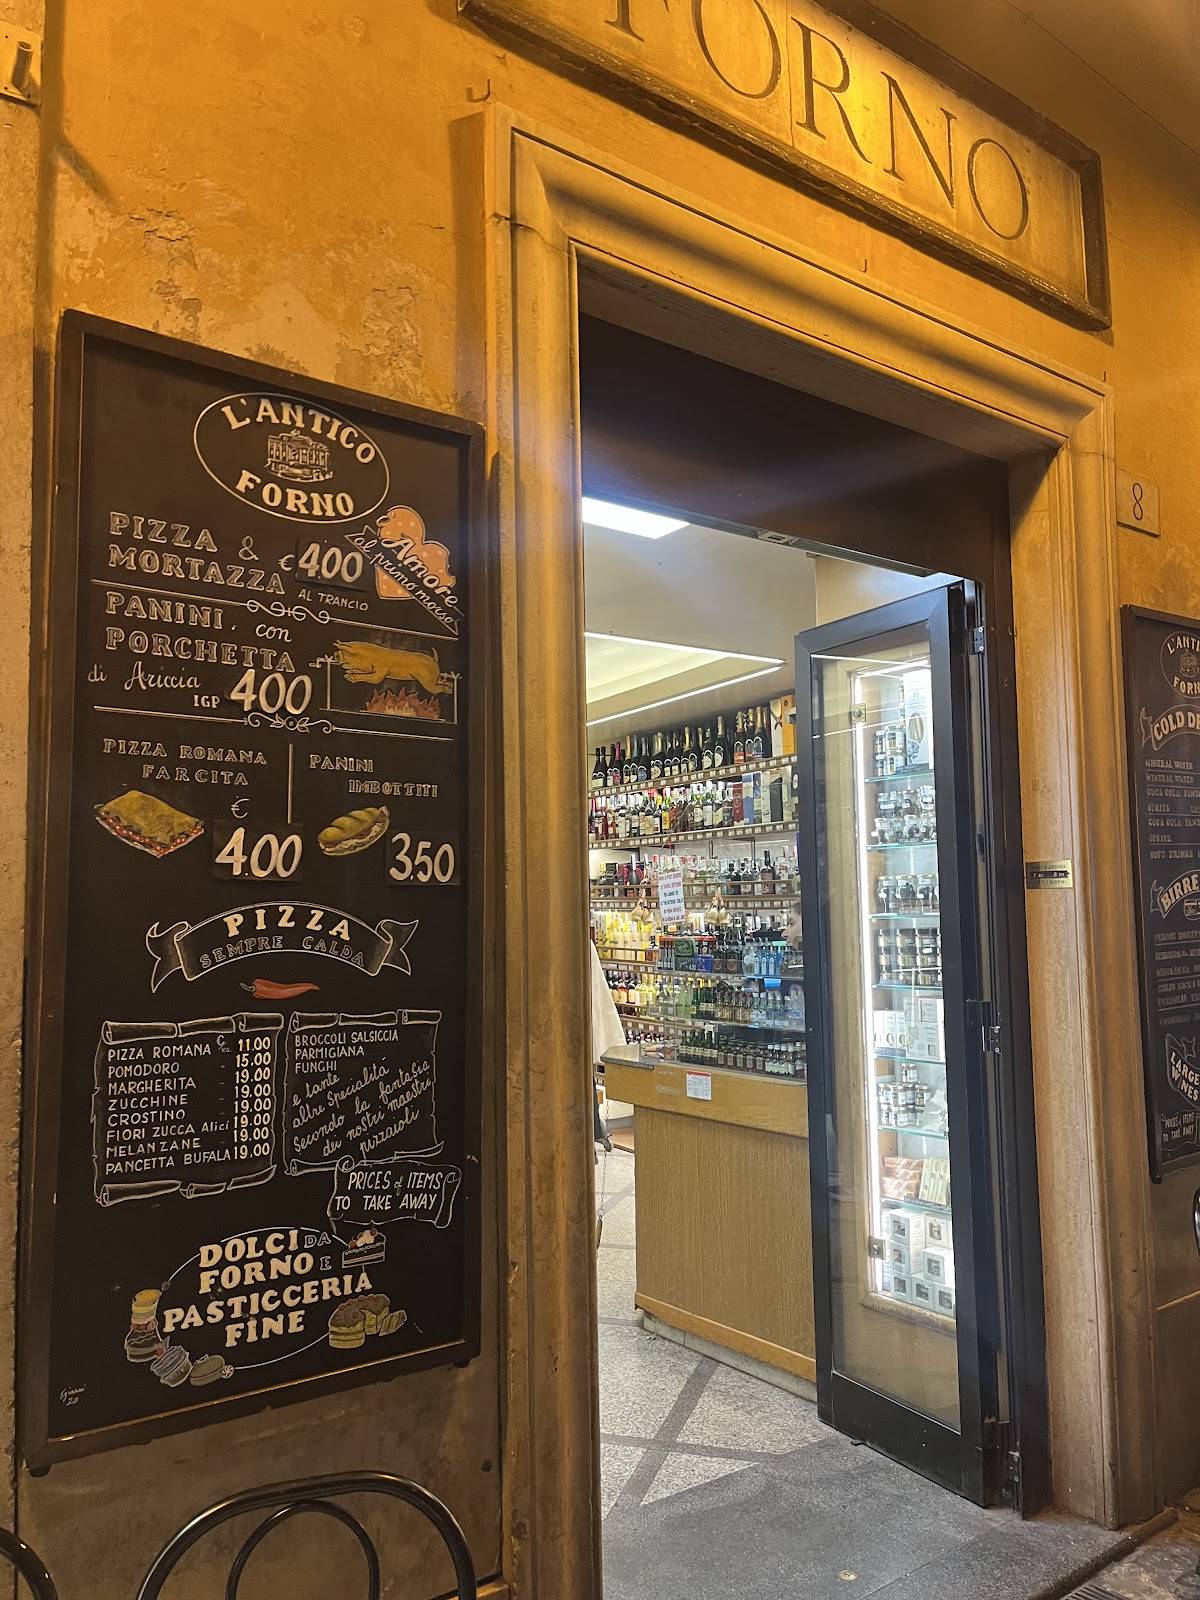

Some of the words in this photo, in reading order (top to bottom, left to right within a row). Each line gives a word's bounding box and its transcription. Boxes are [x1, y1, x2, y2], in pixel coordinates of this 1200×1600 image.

[221, 398, 376, 463] L'ANTICO
[235, 469, 354, 517] FORNO
[1132, 482, 1143, 521] 8
[109, 511, 218, 552] PIZZA
[238, 535, 259, 561] &
[108, 544, 286, 594] MORTAZZA
[354, 537, 378, 553] al
[369, 552, 419, 591] primo
[414, 589, 454, 624] morso
[381, 533, 458, 608] Amore
[297, 588, 313, 602] AL
[318, 591, 368, 612] TRANCIO
[255, 624, 292, 643] con
[105, 626, 295, 673] PORCHETTA
[88, 663, 107, 683] di
[124, 660, 201, 690] Ariccia
[193, 694, 221, 709] IGP
[1153, 710, 1185, 741] COLD
[103, 738, 168, 757] PIZZA
[179, 745, 268, 765] ROMANA
[309, 754, 374, 773] PANINI
[142, 764, 249, 786] FARCITA
[348, 779, 438, 798] IMBOTTITI
[230, 798, 250, 819] €
[223, 905, 351, 941] PIZZA
[199, 935, 284, 969] SEMPRE
[302, 935, 365, 968] CALDA
[294, 1032, 346, 1047] BROCCOLI
[351, 1029, 399, 1044] SALSICCIA
[107, 1048, 145, 1062] PIZZA
[153, 1043, 212, 1059] ROMANA
[294, 1045, 365, 1060] PARMIGIANA
[108, 1061, 180, 1079] POMODORO
[294, 1060, 338, 1074] FUNGHI
[1170, 1051, 1200, 1086] LARGE
[108, 1076, 197, 1096] MARGHERITA
[306, 1071, 341, 1099] tante
[107, 1093, 189, 1111] ZUCCHINE
[355, 1095, 371, 1115] la
[107, 1109, 186, 1127] CROSTINO
[292, 1103, 326, 1129] altre
[106, 1127, 145, 1143] FIORI
[152, 1123, 196, 1138] ZUCCA
[201, 1120, 231, 1133] Alici
[106, 1137, 201, 1159] MELANZANE
[105, 1155, 175, 1175] PANCETTA
[183, 1149, 231, 1165] BUFALA
[347, 1170, 392, 1190] PRICES
[393, 1175, 404, 1197] of
[406, 1171, 444, 1190] ITEMS
[334, 1195, 351, 1211] TO
[363, 1194, 392, 1211] TAKE
[399, 1193, 438, 1211] AWAY
[198, 1229, 299, 1268] DOLCI
[304, 1231, 332, 1249] DA
[198, 1252, 315, 1294] FORNO
[319, 1255, 333, 1271] E
[163, 1272, 373, 1333] PASTICCERIA
[225, 1310, 306, 1348] FINE
